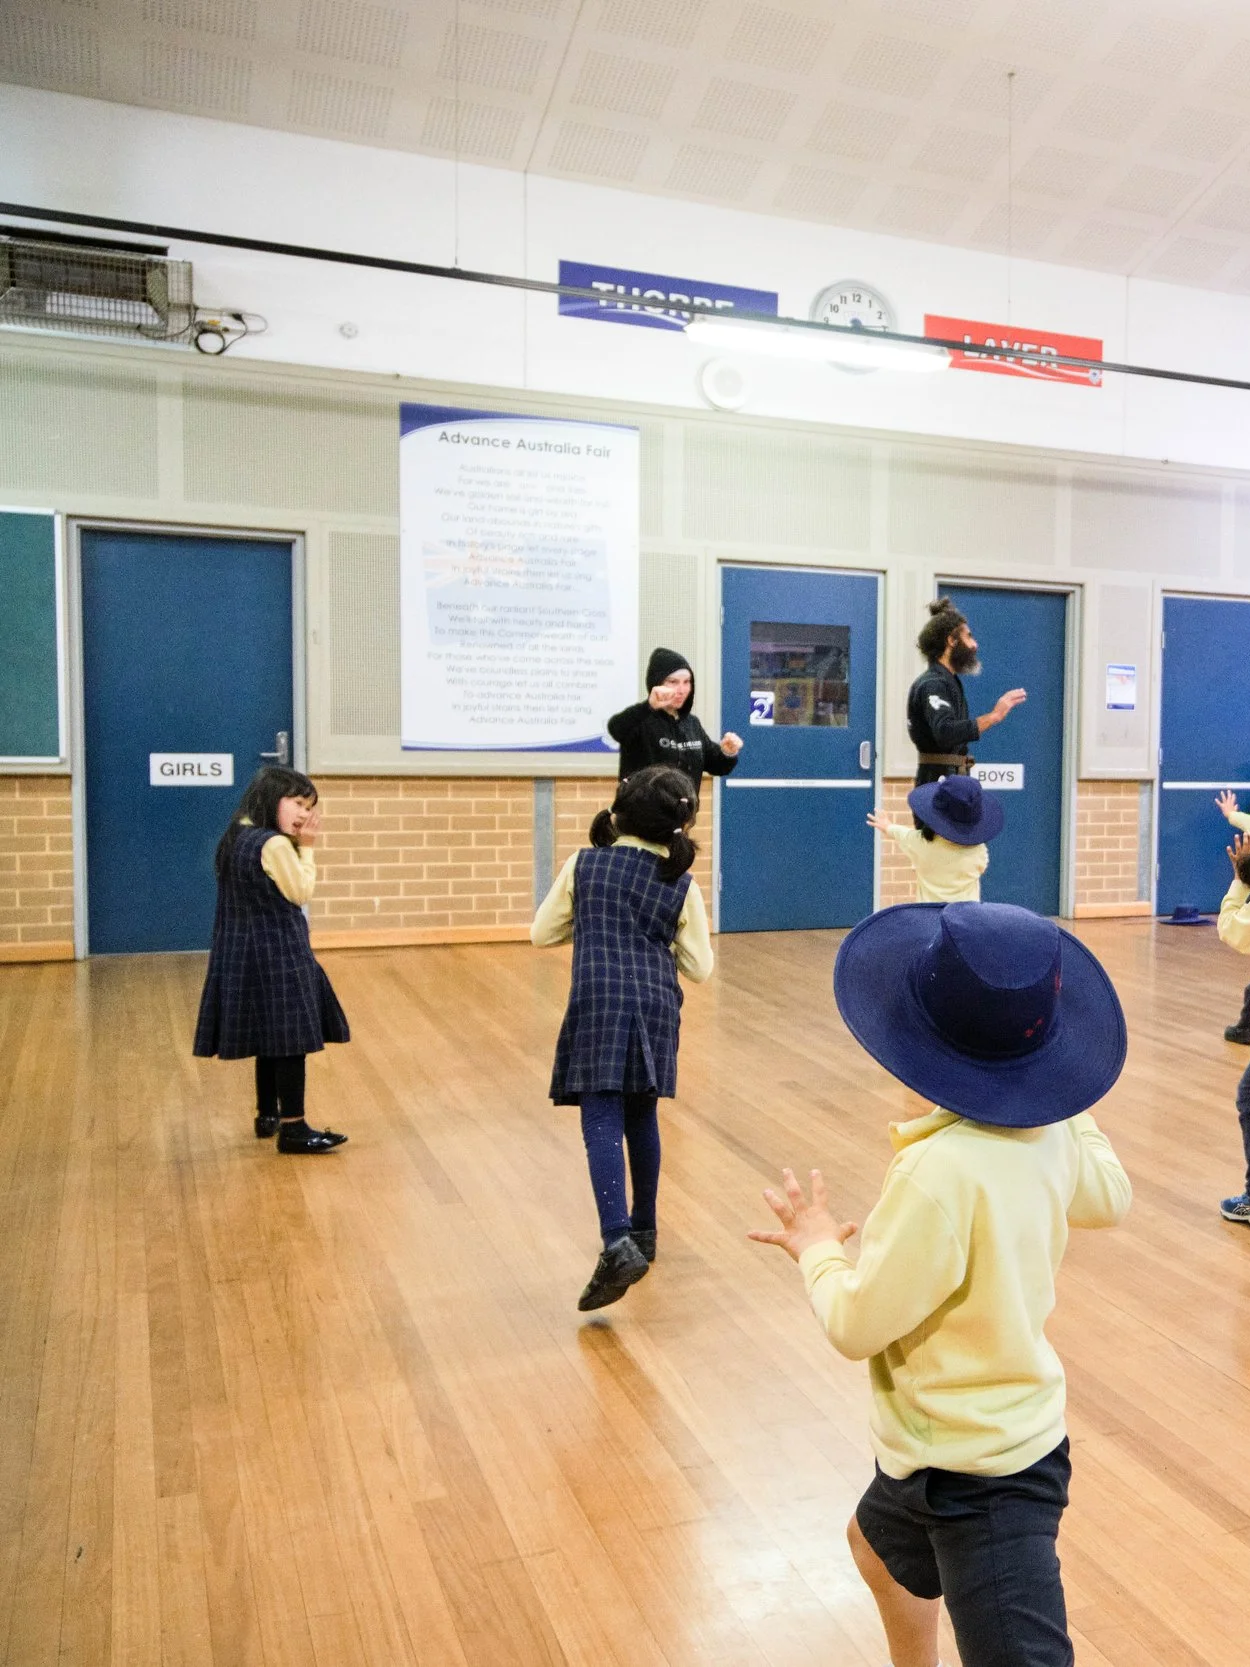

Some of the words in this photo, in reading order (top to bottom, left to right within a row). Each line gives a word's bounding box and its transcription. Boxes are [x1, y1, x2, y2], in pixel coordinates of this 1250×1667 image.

[840, 295, 847, 304] 11
[852, 293, 862, 303] 12
[830, 304, 839, 313] 10
[877, 311, 883, 320] 2
[439, 431, 511, 448] Advance
[516, 438, 581, 455] Australia
[586, 444, 612, 459] Fair
[441, 512, 459, 522] Our
[436, 600, 478, 611] Beneath
[500, 605, 535, 614] radiant
[538, 606, 579, 617] Southern
[545, 620, 564, 629] and
[448, 628, 477, 637] make
[497, 628, 574, 641] Commonwealth
[459, 640, 513, 649] Renowned
[427, 652, 442, 661] For
[513, 656, 542, 664] come
[446, 677, 468, 686] With
[477, 691, 522, 700] advance
[525, 692, 566, 701] Australia
[469, 716, 514, 725] Advance
[517, 716, 558, 726] Australia
[160, 762, 222, 776] GIRLS
[978, 770, 1015, 782] BOYS
